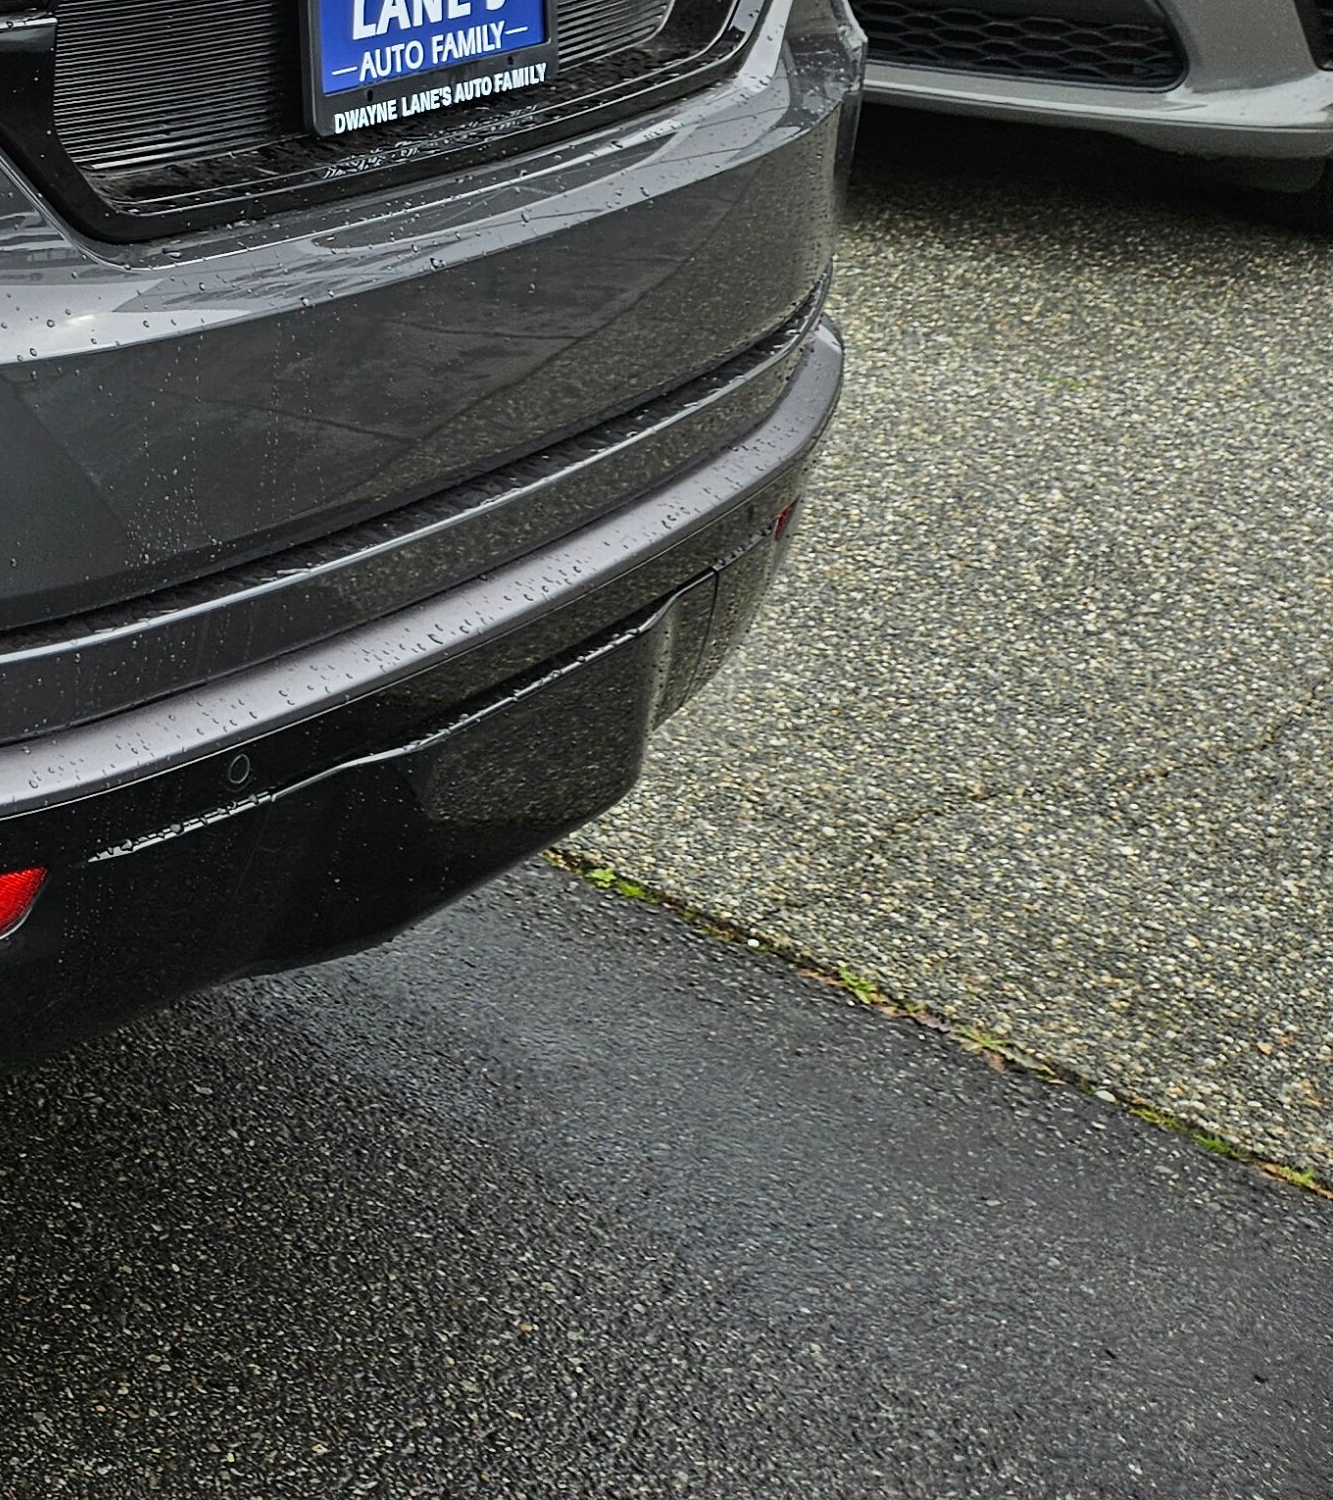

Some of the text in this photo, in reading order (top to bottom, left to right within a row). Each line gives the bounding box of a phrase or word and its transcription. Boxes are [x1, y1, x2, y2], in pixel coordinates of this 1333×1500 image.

[359, 20, 507, 82] AUTO FAMILY
[334, 62, 548, 135] DWAYNE LANE'S AUTO FAMILY
